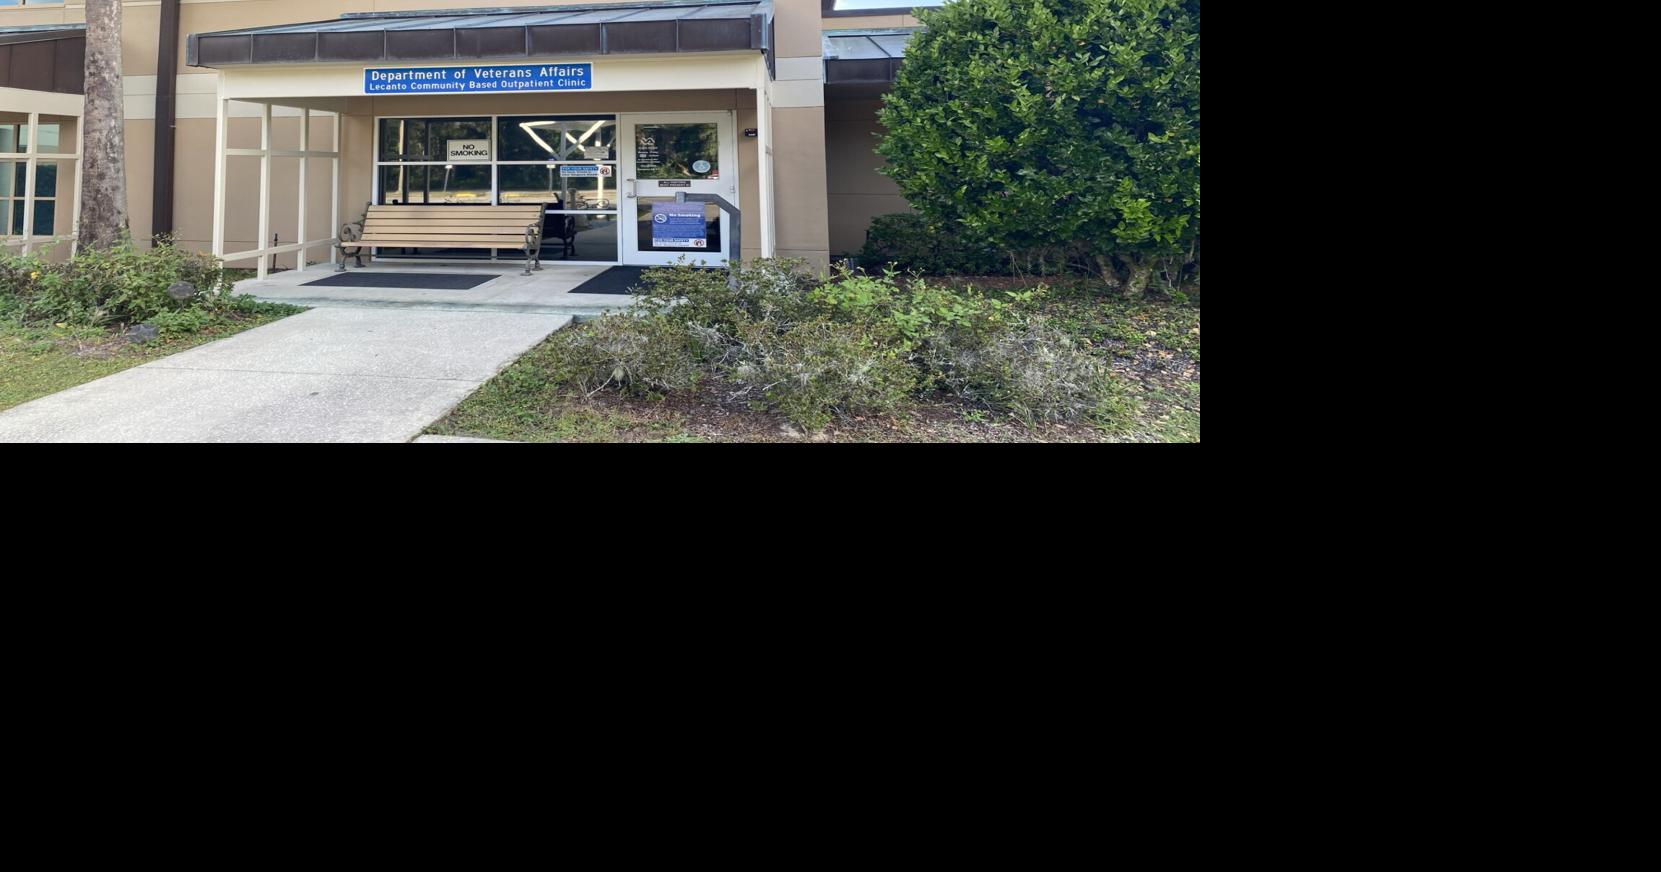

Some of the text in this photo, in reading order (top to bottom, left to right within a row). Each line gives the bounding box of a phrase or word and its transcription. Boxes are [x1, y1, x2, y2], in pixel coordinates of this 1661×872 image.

[371, 66, 584, 83] Department of Veterans Affairs
[369, 78, 586, 90] Lecanto Community Based Outpatient Clinic
